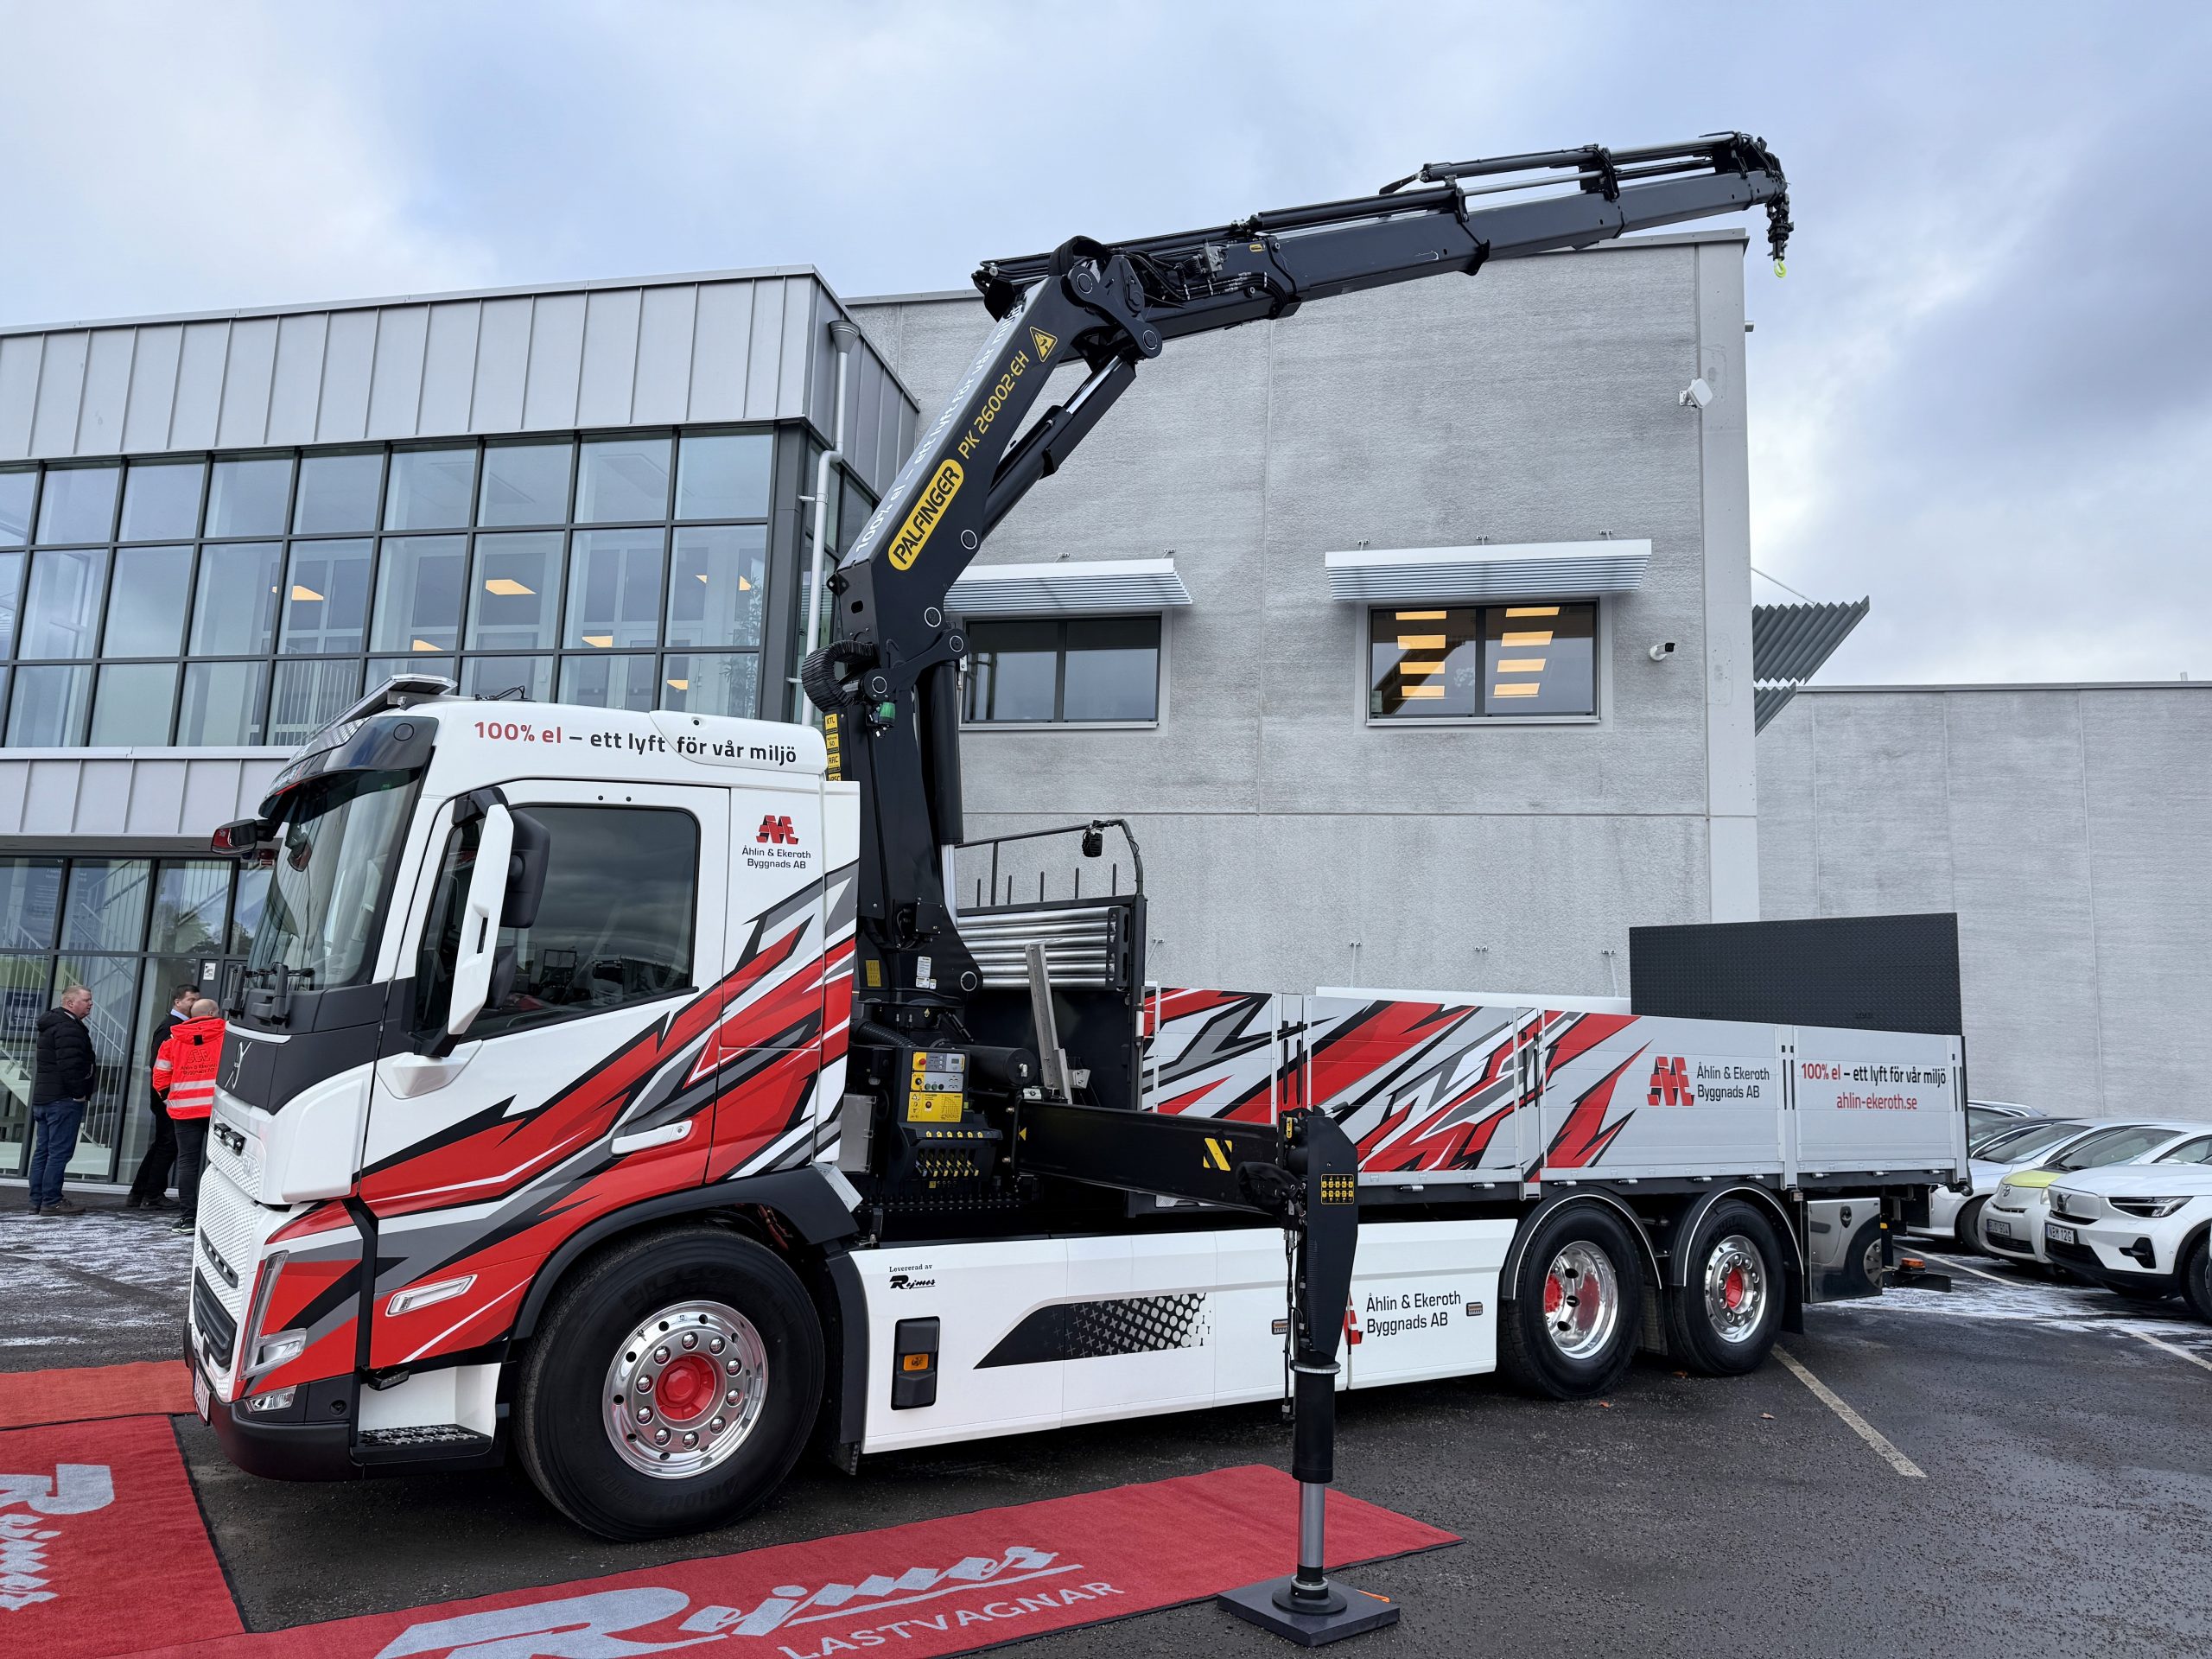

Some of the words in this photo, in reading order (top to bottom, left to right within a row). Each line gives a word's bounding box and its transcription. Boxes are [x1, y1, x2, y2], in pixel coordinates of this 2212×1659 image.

[856, 504, 893, 553] 100%
[893, 485, 906, 501] el
[914, 438, 937, 464] ett
[929, 404, 957, 437] lyft
[953, 378, 975, 404] för
[972, 348, 995, 377] vår
[993, 304, 1023, 345] miljö
[957, 432, 980, 460] PK
[893, 466, 961, 564] PALFINGER
[474, 722, 535, 742] 100%
[542, 726, 562, 744] el
[590, 732, 622, 749] ett
[628, 733, 665, 755] lyft
[677, 736, 707, 754] för
[713, 739, 744, 758] vår
[750, 743, 797, 766] miljö
[742, 845, 765, 856] Åhlin
[767, 849, 774, 857] &
[777, 849, 811, 859] Ekeroth
[747, 858, 791, 869] Byggnads
[792, 861, 806, 869] AB
[1696, 1061, 1720, 1079] Åhlin
[1723, 1066, 1732, 1079] &
[1733, 1066, 1770, 1081] Ekeroth
[1801, 1063, 1829, 1080] 100%
[1831, 1064, 1841, 1080] el
[1853, 1065, 1868, 1082] ett
[1870, 1065, 1887, 1086] lyft
[1890, 1066, 1904, 1083] för
[1906, 1066, 1921, 1084] vår
[1923, 1068, 1946, 1088] miljö
[1697, 1084, 1744, 1102] Byggnads
[1745, 1085, 1760, 1098] AB
[1836, 1092, 1917, 1110] ahlin-ekeroth.se
[889, 1264, 923, 1273] Levererad
[1366, 1293, 1397, 1313] Åhlin
[1402, 1294, 1411, 1309] &
[1414, 1290, 1461, 1308] Ekeroth
[1367, 1314, 1427, 1337] Byggnads
[1430, 1312, 1448, 1327] AB
[779, 1580, 1126, 1659] LASTVAGNAR
